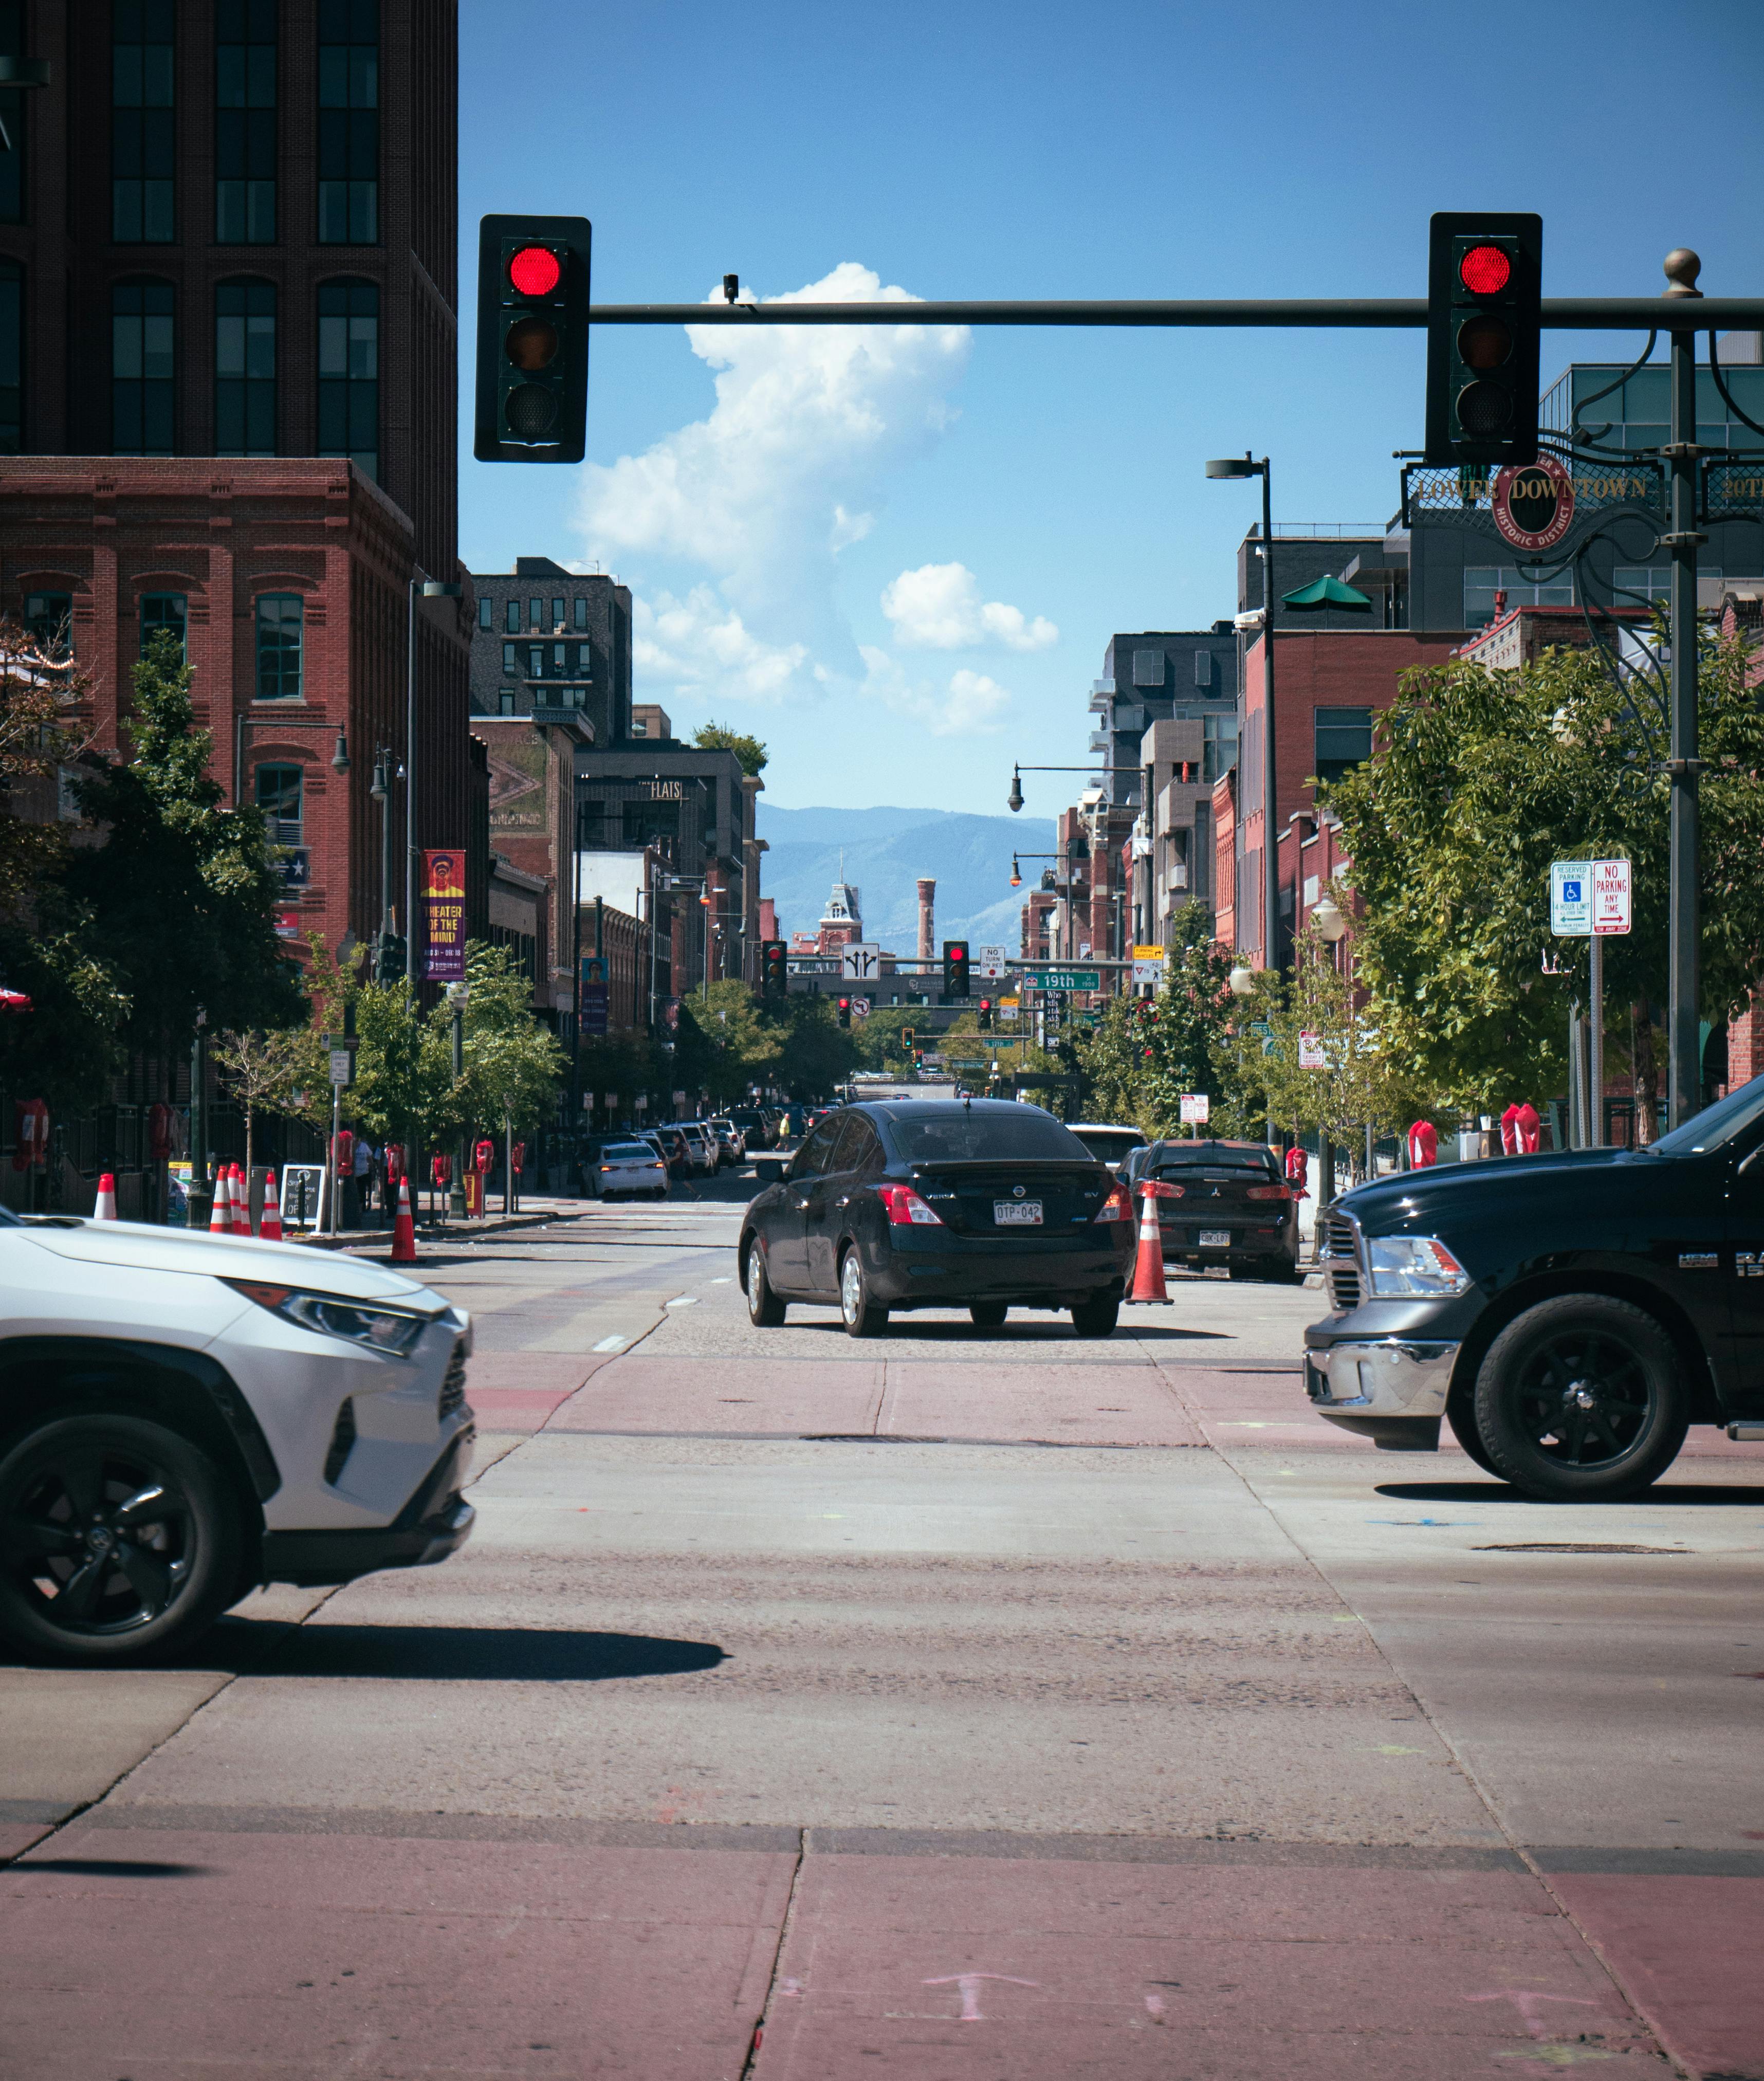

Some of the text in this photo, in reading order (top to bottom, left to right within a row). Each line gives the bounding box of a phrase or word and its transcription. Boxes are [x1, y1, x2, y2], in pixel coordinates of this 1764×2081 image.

[1418, 478, 1645, 499] LOWER DOWNTOWN
[1496, 507, 1532, 546] HISTORIC
[1538, 505, 1570, 546] DISTRICT
[651, 781, 680, 798] FLATS
[1605, 865, 1618, 879] NO
[1596, 880, 1627, 893] PARKING
[1605, 895, 1618, 903] ANY
[424, 906, 462, 917] THEATER
[1605, 904, 1619, 914] TIME
[429, 919, 458, 930] OF THE
[430, 932, 455, 943] MIND
[1044, 975, 1074, 987] 19th
